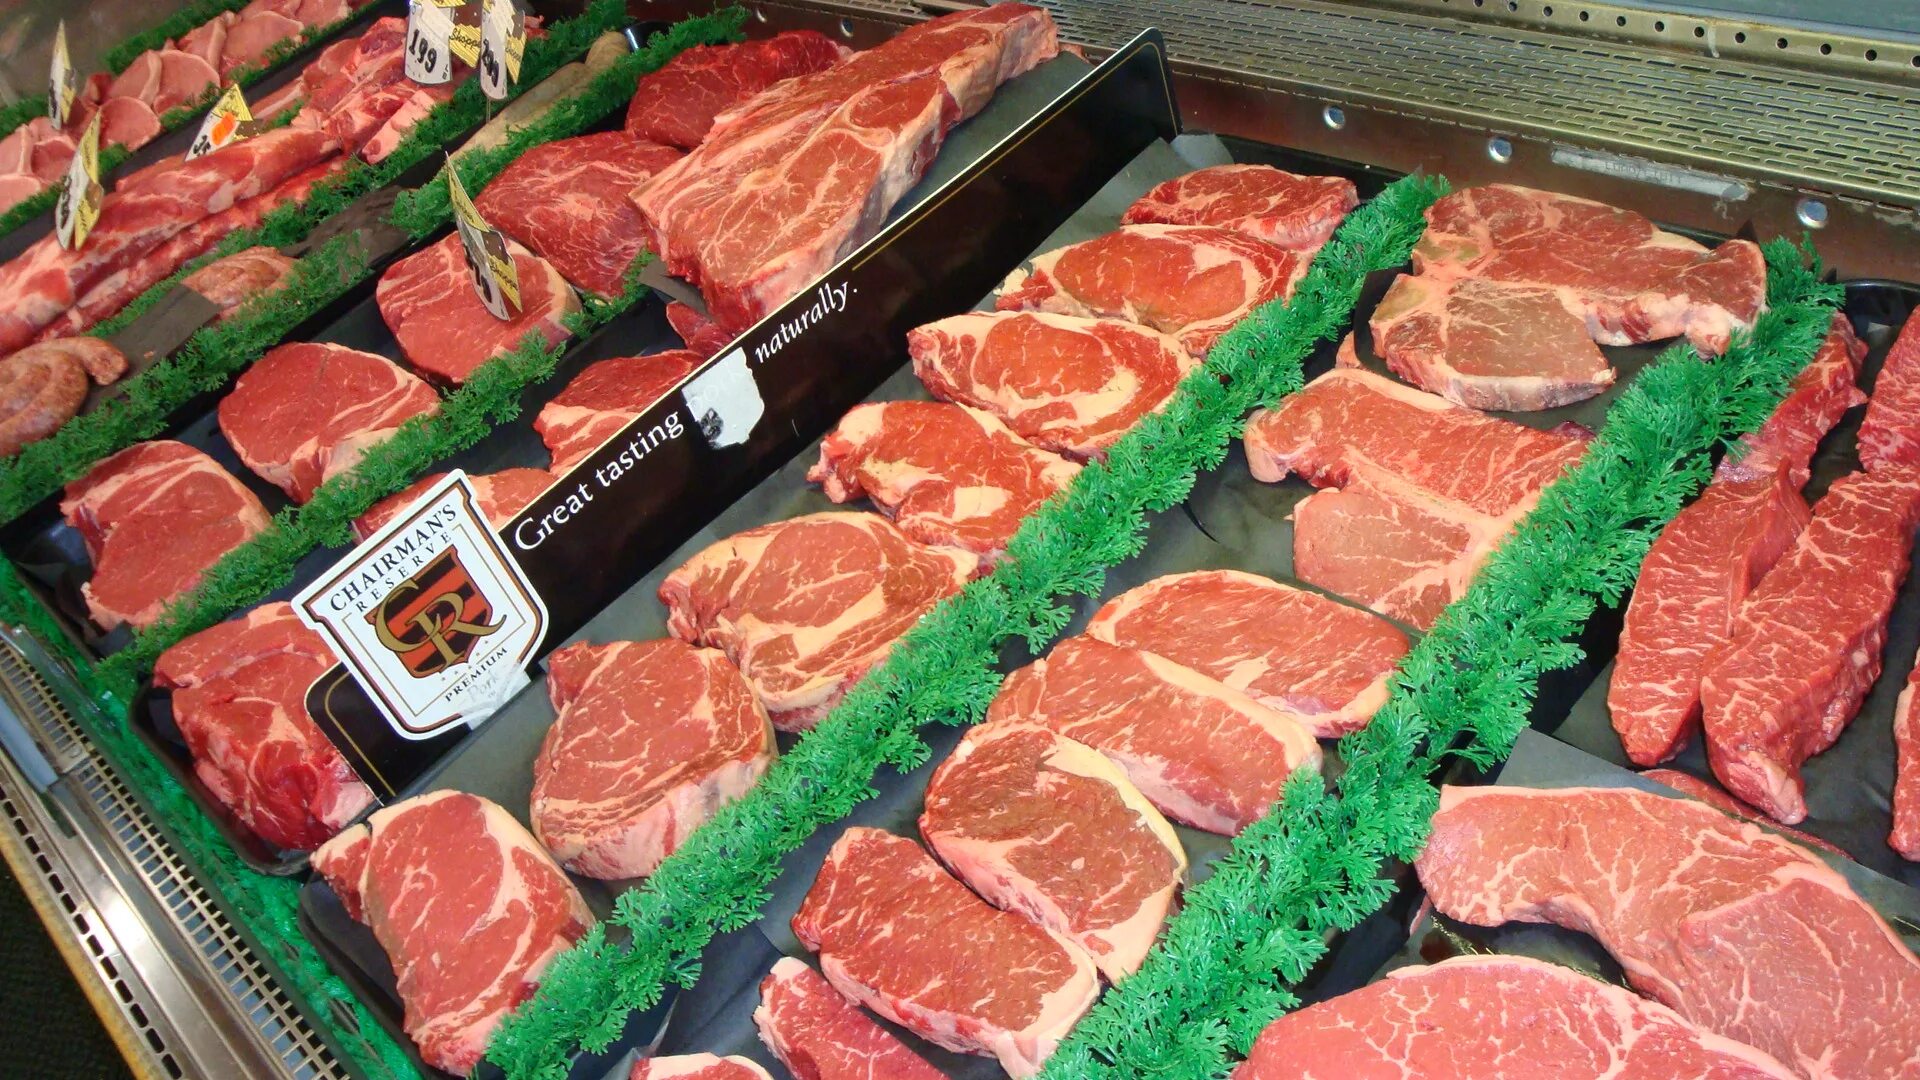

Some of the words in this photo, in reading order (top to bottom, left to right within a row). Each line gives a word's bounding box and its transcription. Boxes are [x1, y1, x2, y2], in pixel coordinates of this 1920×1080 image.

[408, 29, 437, 74] 199
[514, 482, 594, 550] Great
[595, 411, 684, 488] tasting
[755, 281, 858, 363] naturally.
[330, 504, 457, 612] CHAIRMAN'S
[356, 531, 451, 613] RESERVE
[375, 577, 508, 672] CR
[445, 647, 508, 702] PREMIUM
